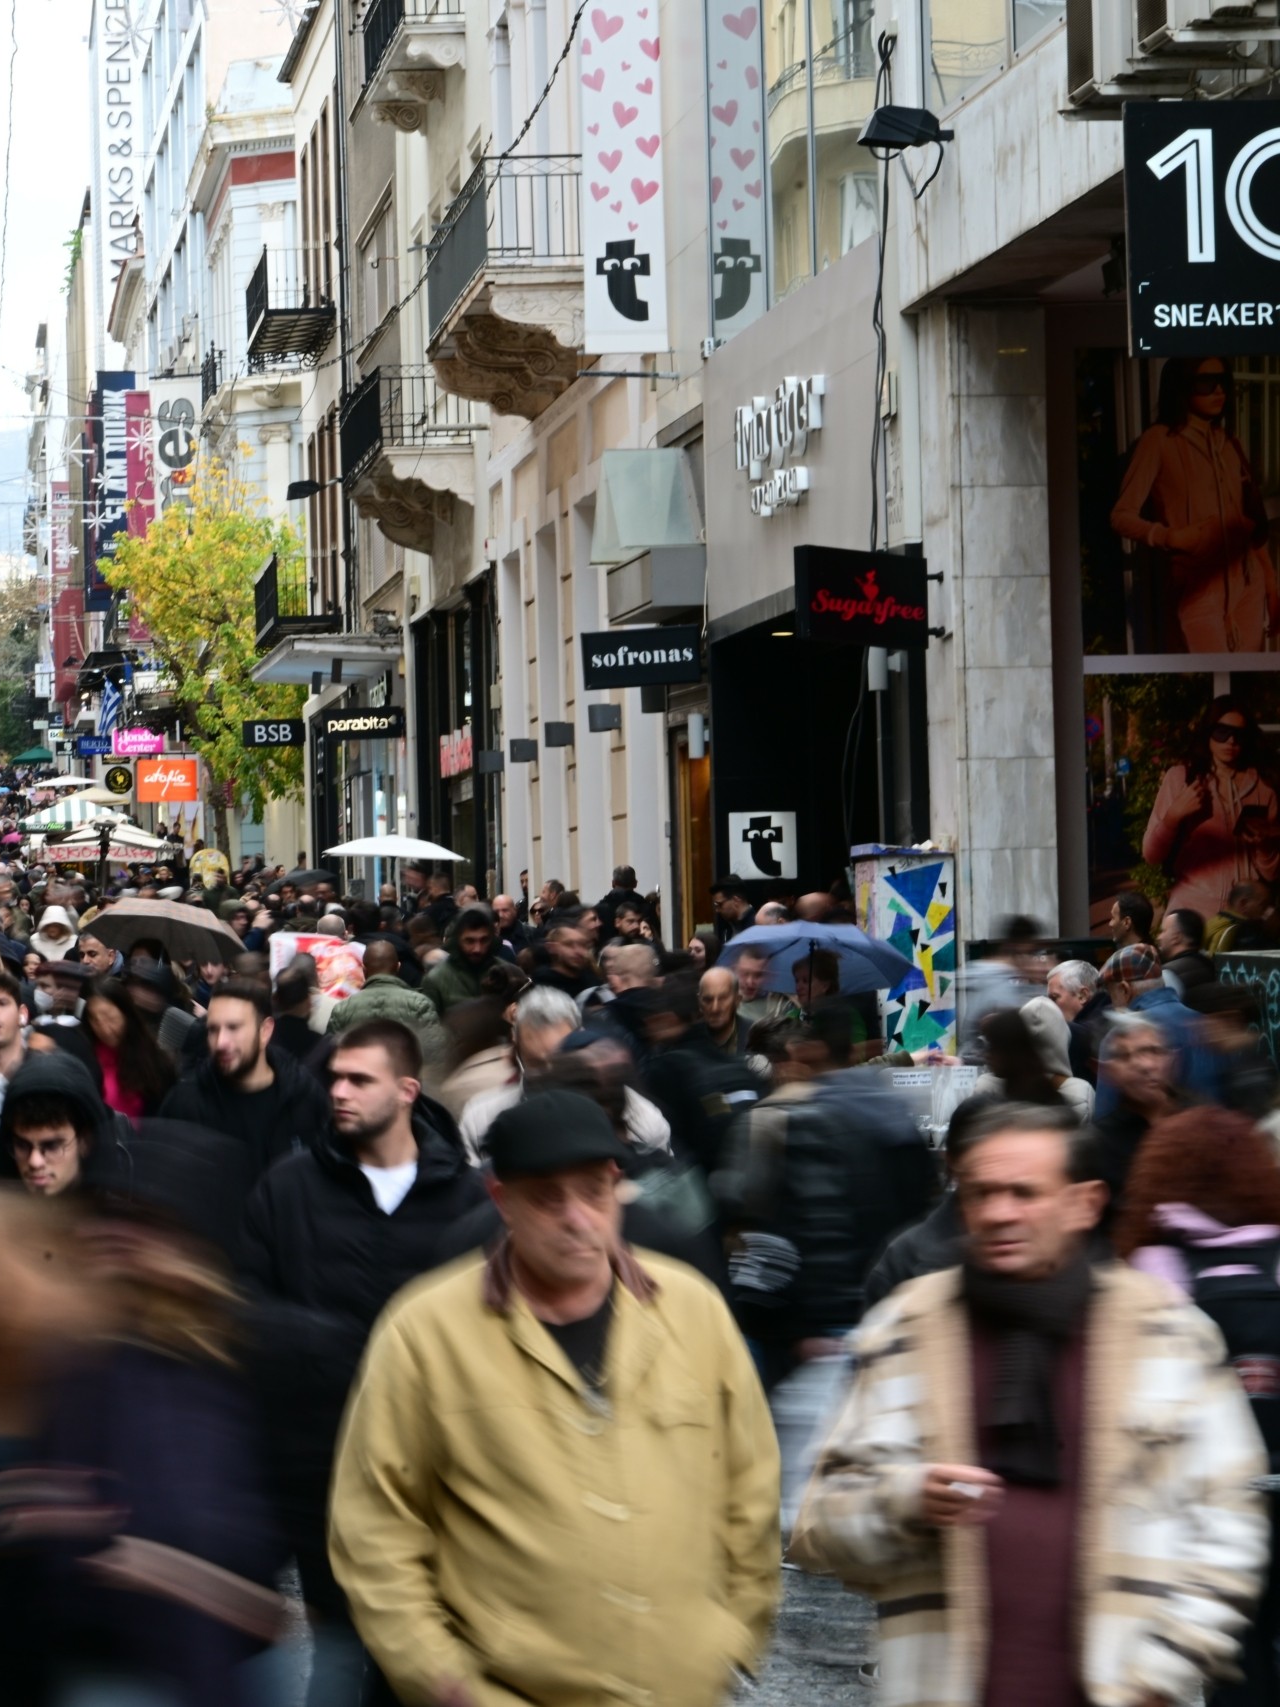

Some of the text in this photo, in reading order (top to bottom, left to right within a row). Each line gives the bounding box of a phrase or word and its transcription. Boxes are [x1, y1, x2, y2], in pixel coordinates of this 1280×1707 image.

[108, 142, 133, 159] &
[107, 165, 136, 283] MARKS
[1154, 302, 1280, 327] SNEAKER
[811, 588, 926, 625] Sugarfree
[591, 645, 694, 669] sofronas
[254, 723, 292, 743] BSB
[327, 716, 389, 734] parabita
[118, 741, 156, 754] Center
